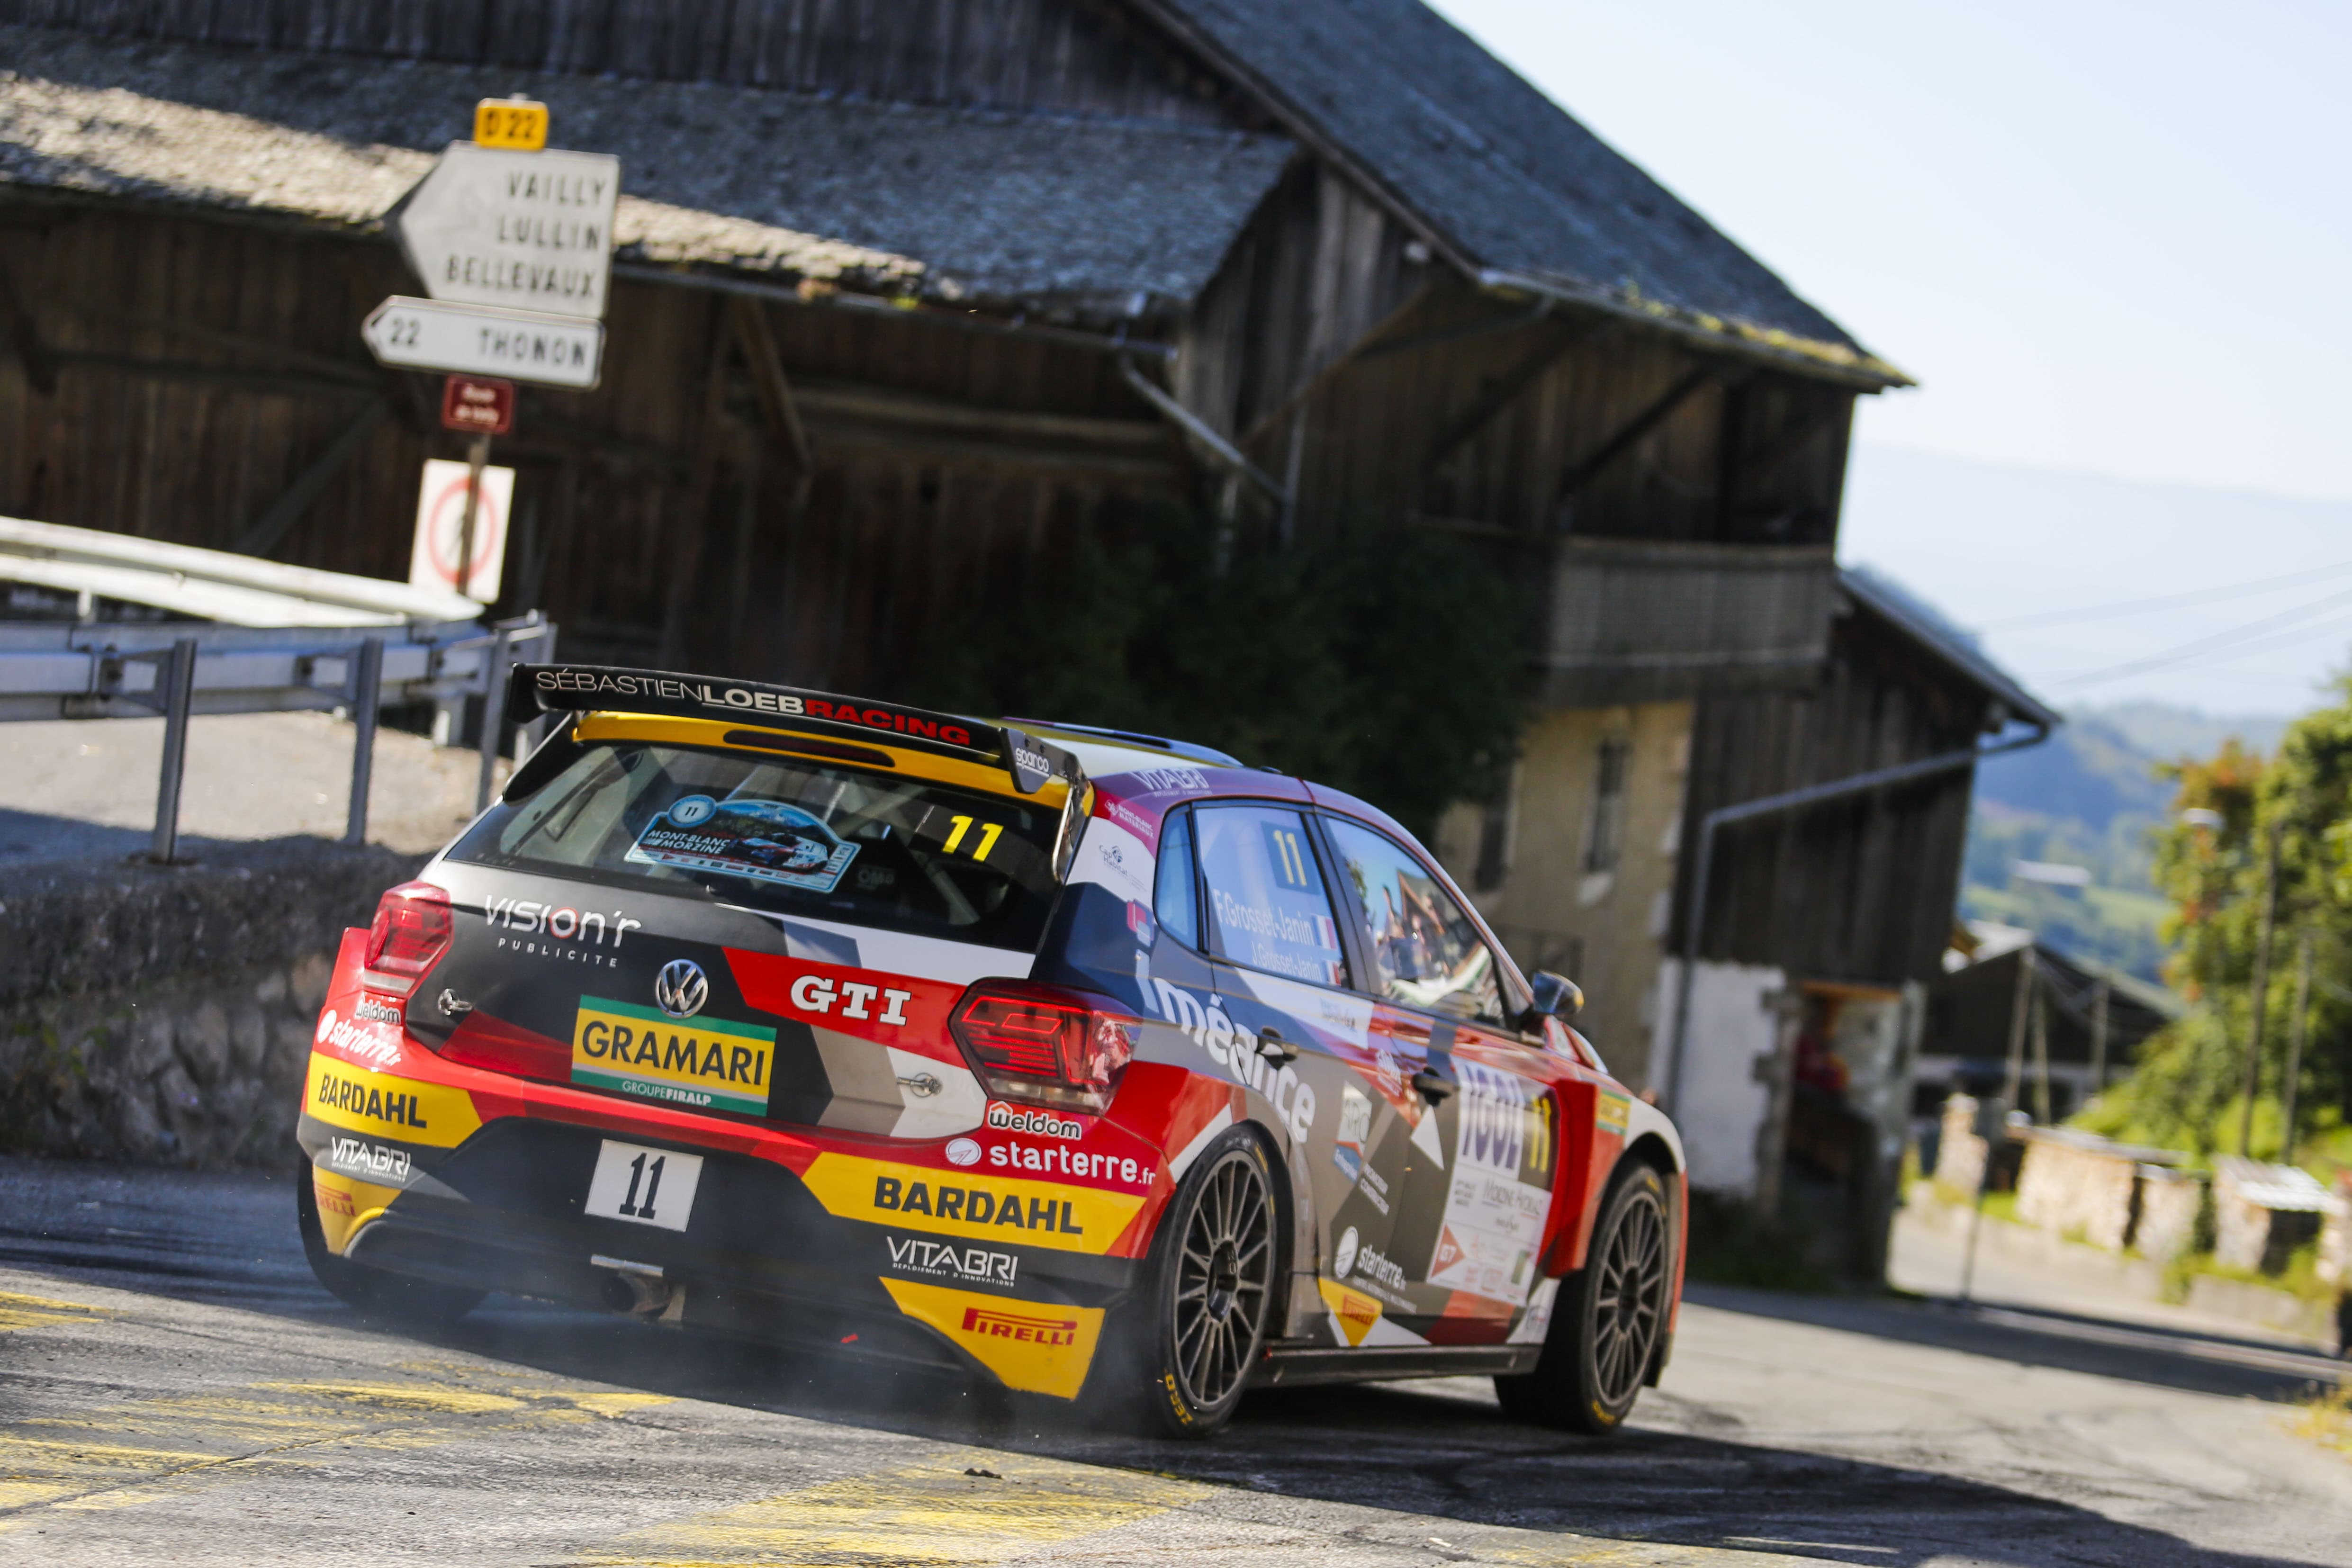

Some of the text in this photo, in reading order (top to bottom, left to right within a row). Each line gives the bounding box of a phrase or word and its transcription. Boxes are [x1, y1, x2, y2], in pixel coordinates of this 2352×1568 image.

[485, 110, 539, 139] D 22
[508, 171, 606, 206] VAILLY
[498, 216, 602, 250] LULLIN
[447, 256, 594, 297] BELLEVAUX
[390, 317, 587, 366] 22 THONON
[1015, 746, 1049, 773] sparco
[685, 806, 698, 817] 11
[647, 830, 730, 847] MONT-BLANC
[660, 840, 724, 855] MORZINE
[942, 815, 1004, 862] 11
[1273, 829, 1307, 886] 11
[498, 938, 617, 968] PUBLICITE
[791, 975, 911, 1026] GTI
[582, 1021, 765, 1086] GRAMARI
[318, 1072, 428, 1129] BARDAHL
[988, 1109, 1081, 1139] weldom
[1529, 1095, 1551, 1172] 11
[331, 1136, 411, 1176] VITABRI
[990, 1142, 1155, 1185] starterre.fr
[619, 1153, 666, 1219] 11
[874, 1176, 1083, 1235] BARDAHL
[886, 1235, 1018, 1281] VITABRI
[892, 1262, 947, 1276] DEPLOIEMENT
[962, 1307, 1078, 1346] PIRELLI
